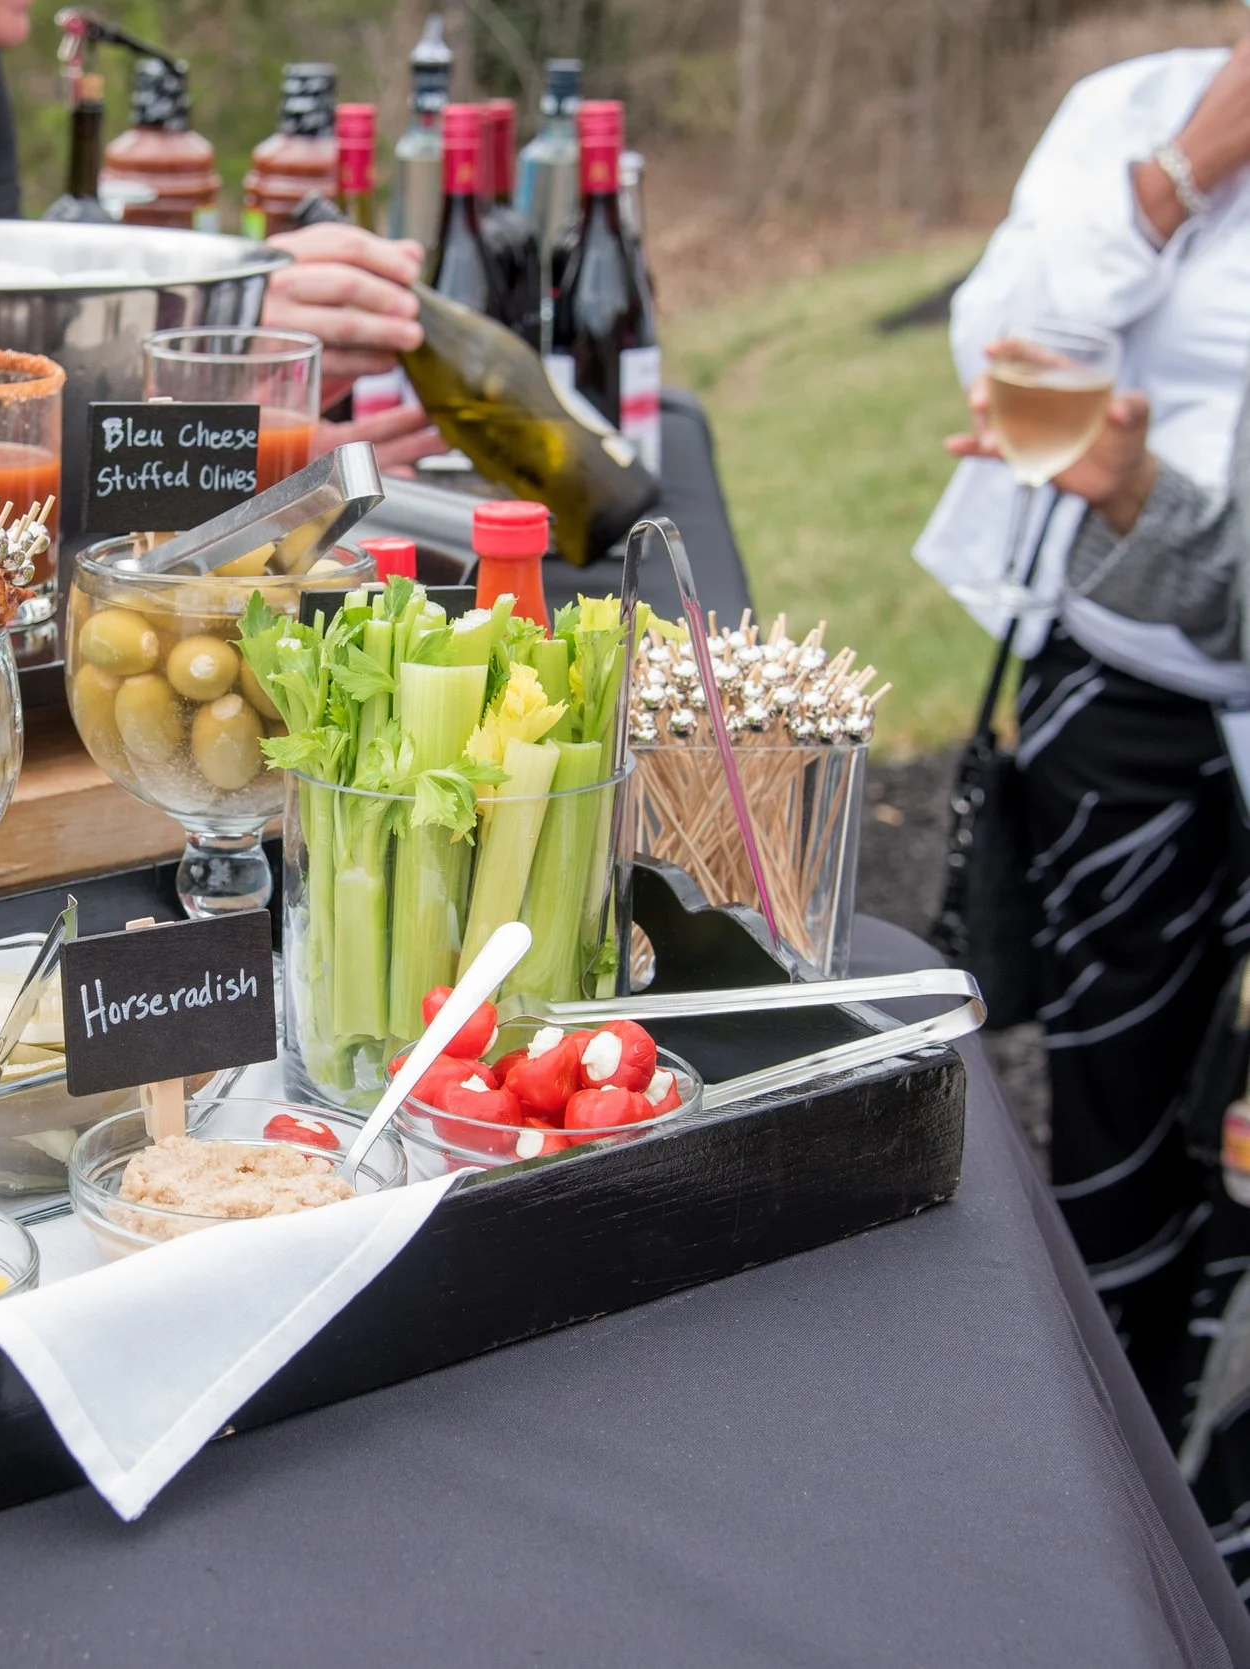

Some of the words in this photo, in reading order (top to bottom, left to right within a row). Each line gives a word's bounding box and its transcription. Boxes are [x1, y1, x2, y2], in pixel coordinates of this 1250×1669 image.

[102, 417, 164, 453] Bleu
[178, 420, 258, 449] Cheese
[96, 460, 190, 497] Stuffed
[199, 464, 257, 493] Olives
[80, 968, 258, 1039] Horseradish
